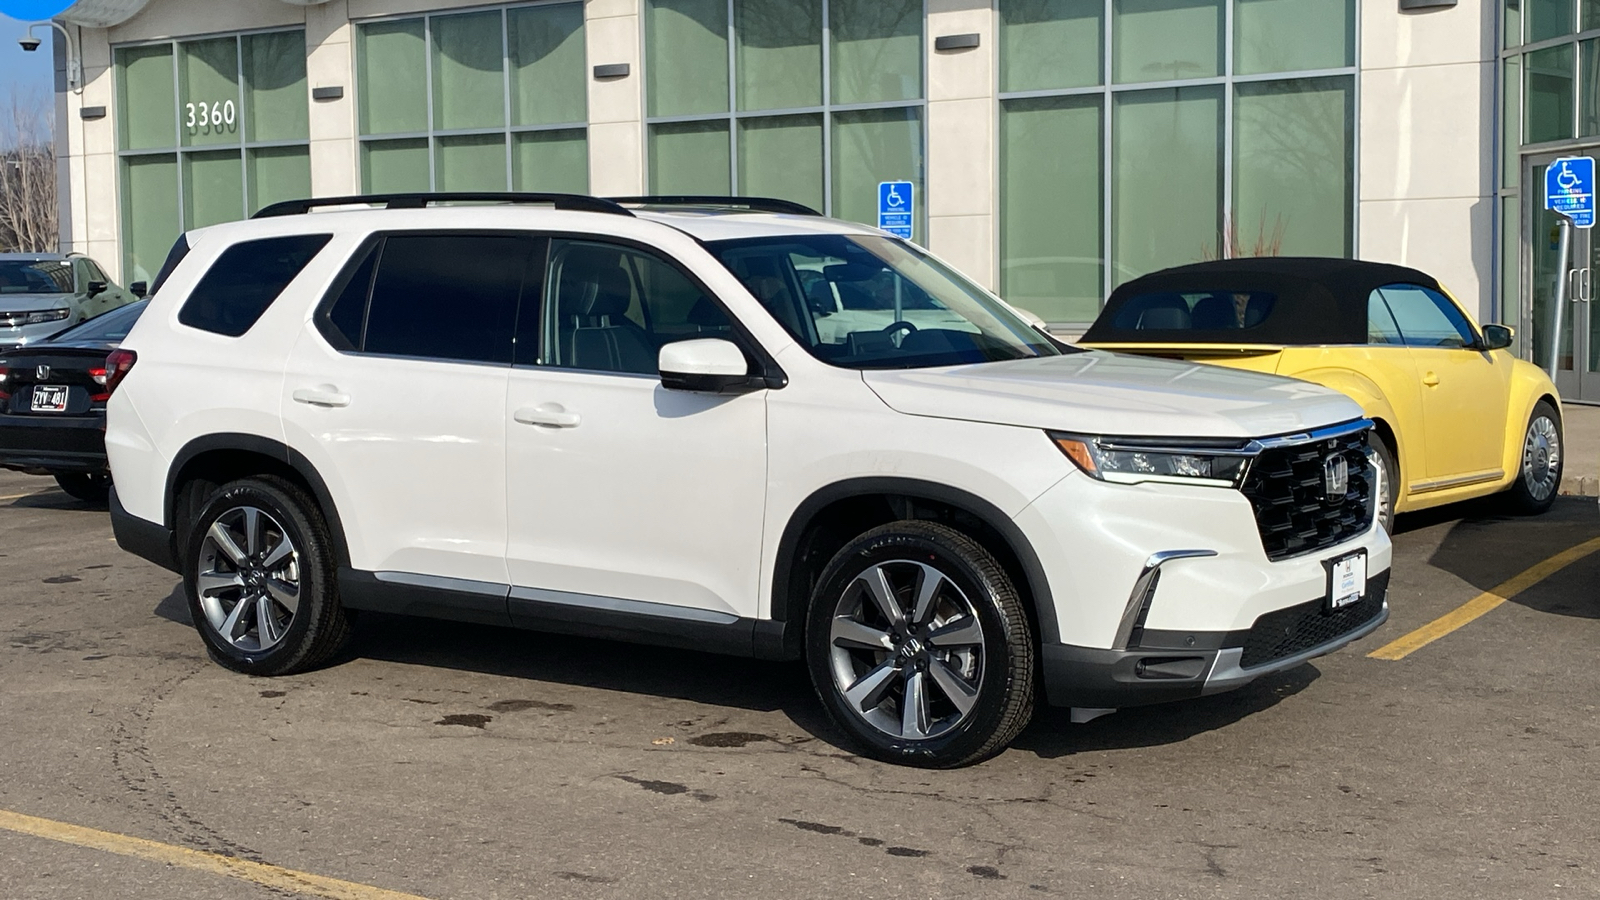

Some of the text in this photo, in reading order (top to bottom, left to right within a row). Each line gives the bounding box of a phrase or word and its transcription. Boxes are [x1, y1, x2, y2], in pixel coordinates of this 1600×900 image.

[186, 100, 235, 127] 3360
[33, 391, 65, 405] ZYV 481
